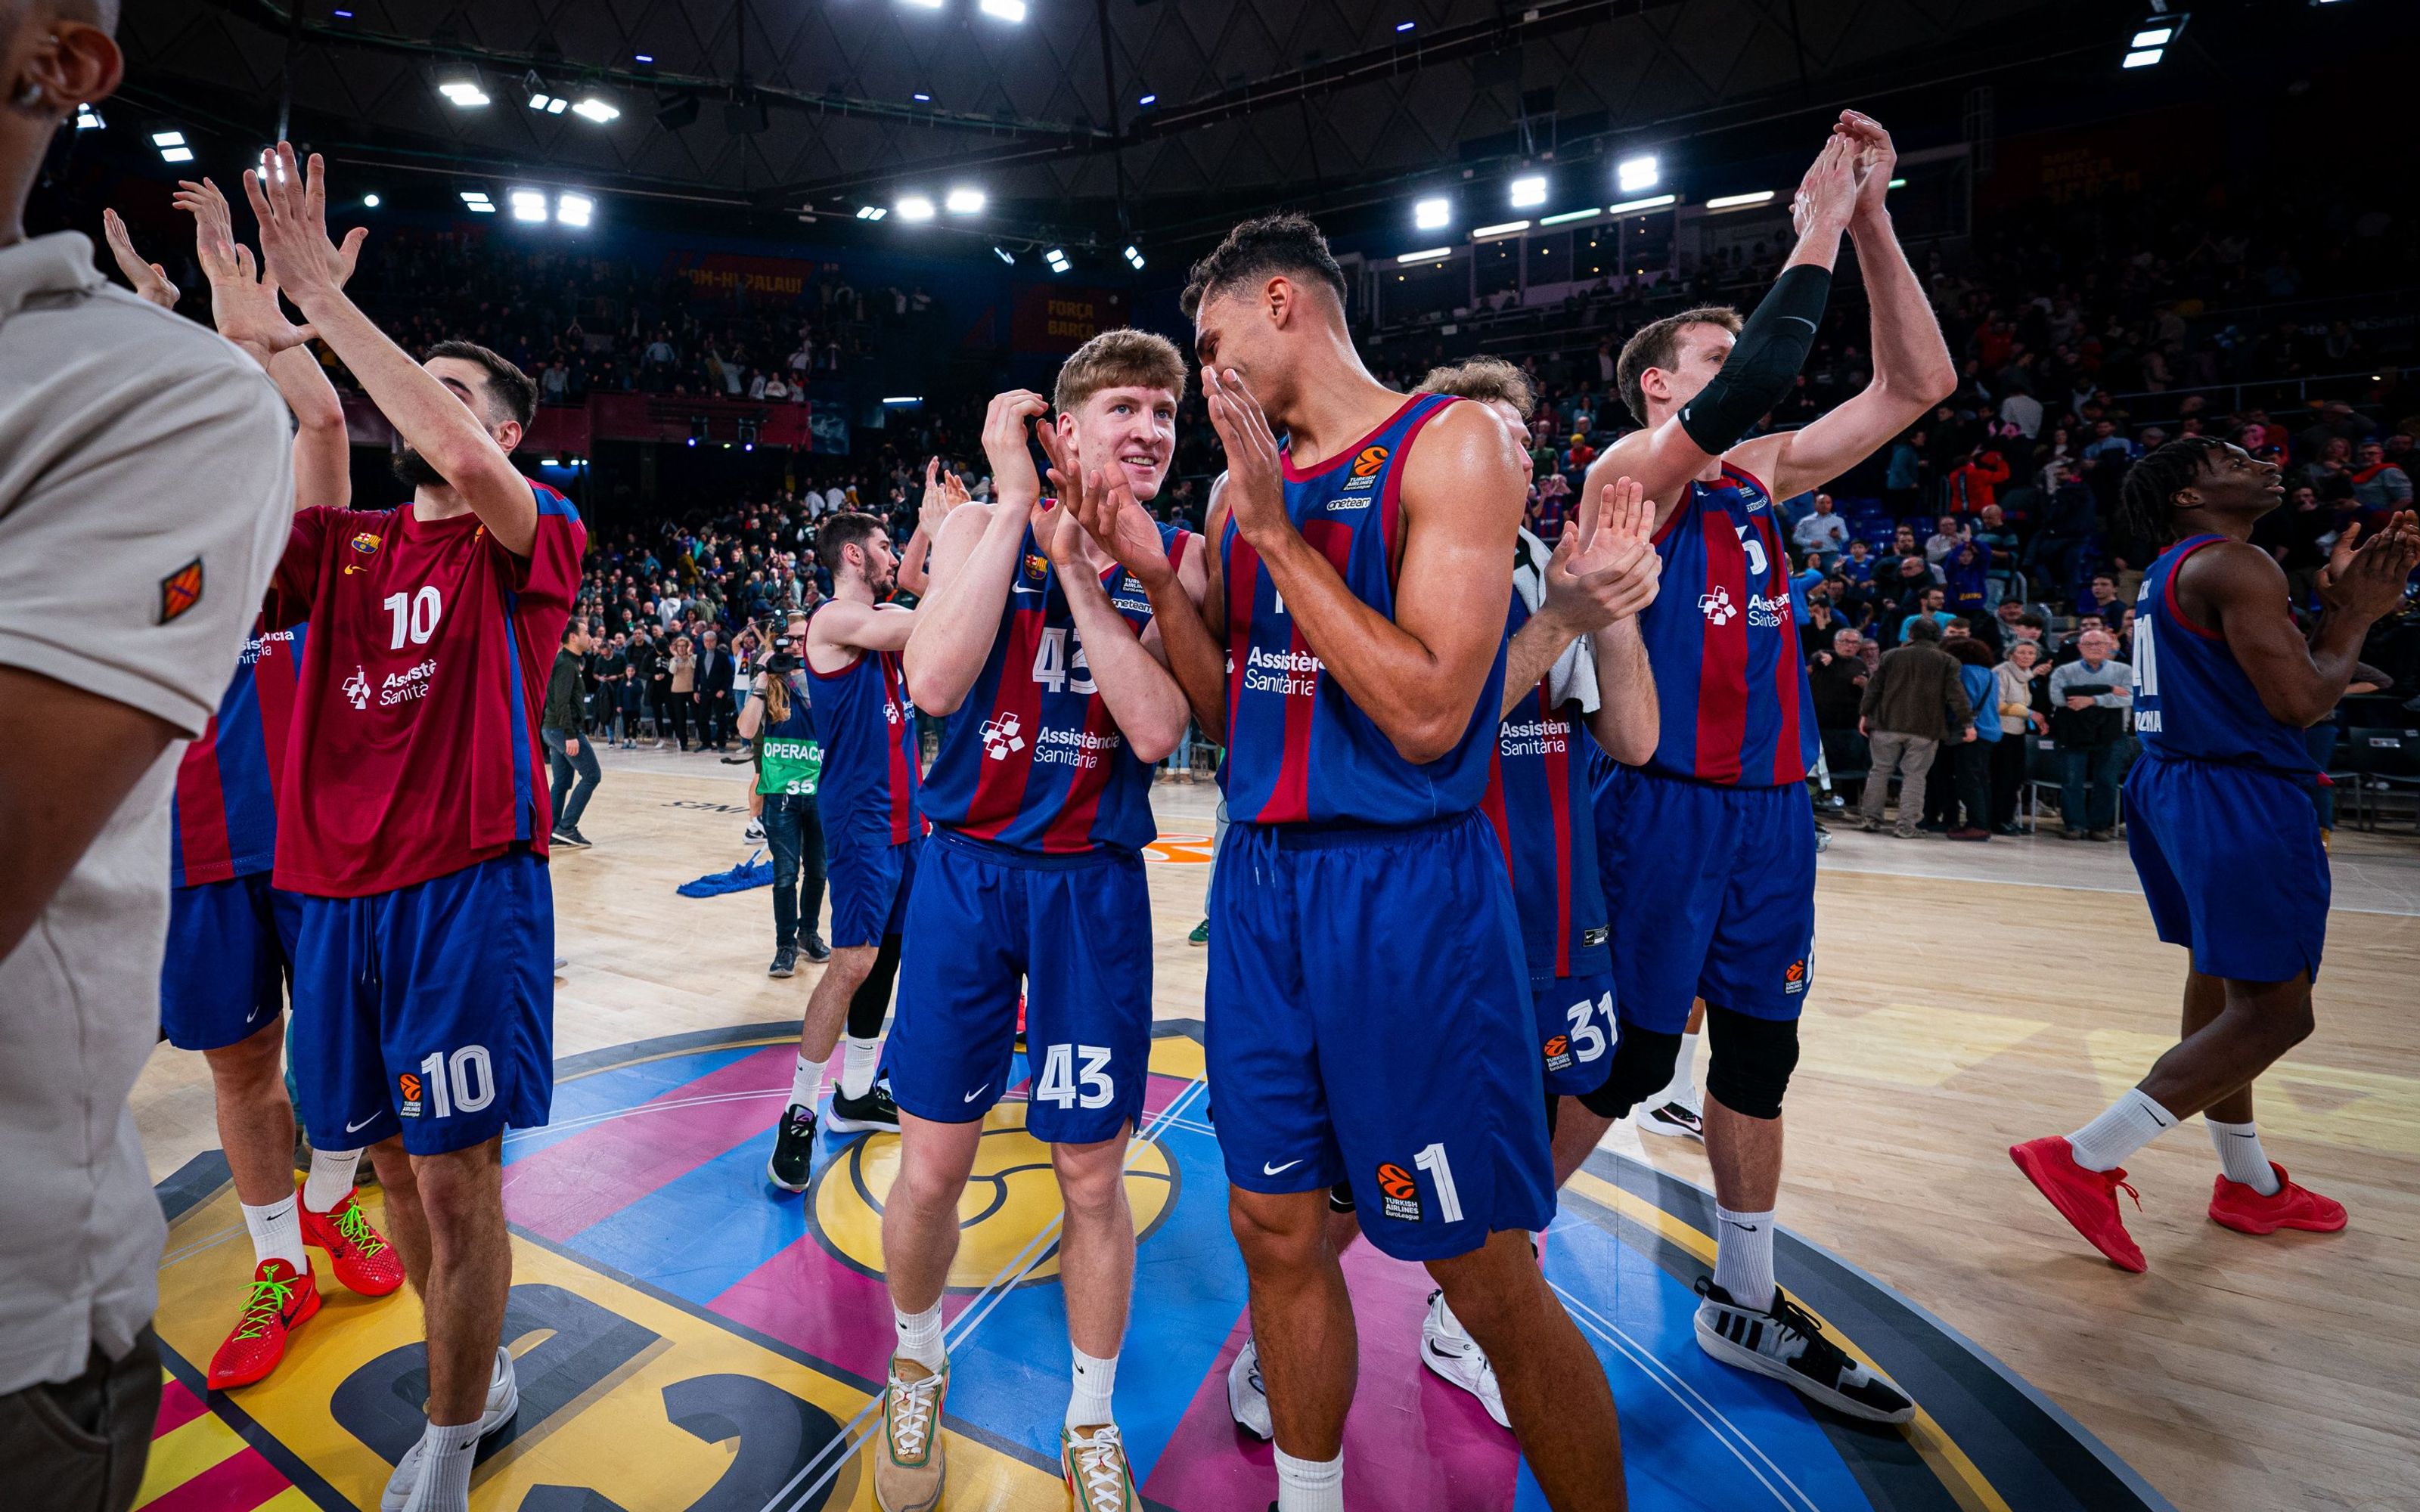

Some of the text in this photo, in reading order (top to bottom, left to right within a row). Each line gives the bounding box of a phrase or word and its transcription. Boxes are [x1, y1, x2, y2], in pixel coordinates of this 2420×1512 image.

[1047, 299, 1094, 320] FORÇA
[384, 585, 442, 650] 10
[1032, 627, 1099, 695] 43
[1036, 727, 1120, 750] Assistència
[1501, 736, 1566, 757] Sanitària
[1034, 745, 1098, 769] Sanitària
[786, 779, 815, 795] 35
[1567, 990, 1618, 1063] 31
[421, 1045, 495, 1119] 10
[1037, 1044, 1115, 1109] 43
[1413, 1142, 1464, 1223] 1
[1385, 1197, 1418, 1207] TURKISH
[1385, 1204, 1419, 1214] AIRLINES
[1385, 1210, 1419, 1221] EuroLeague
